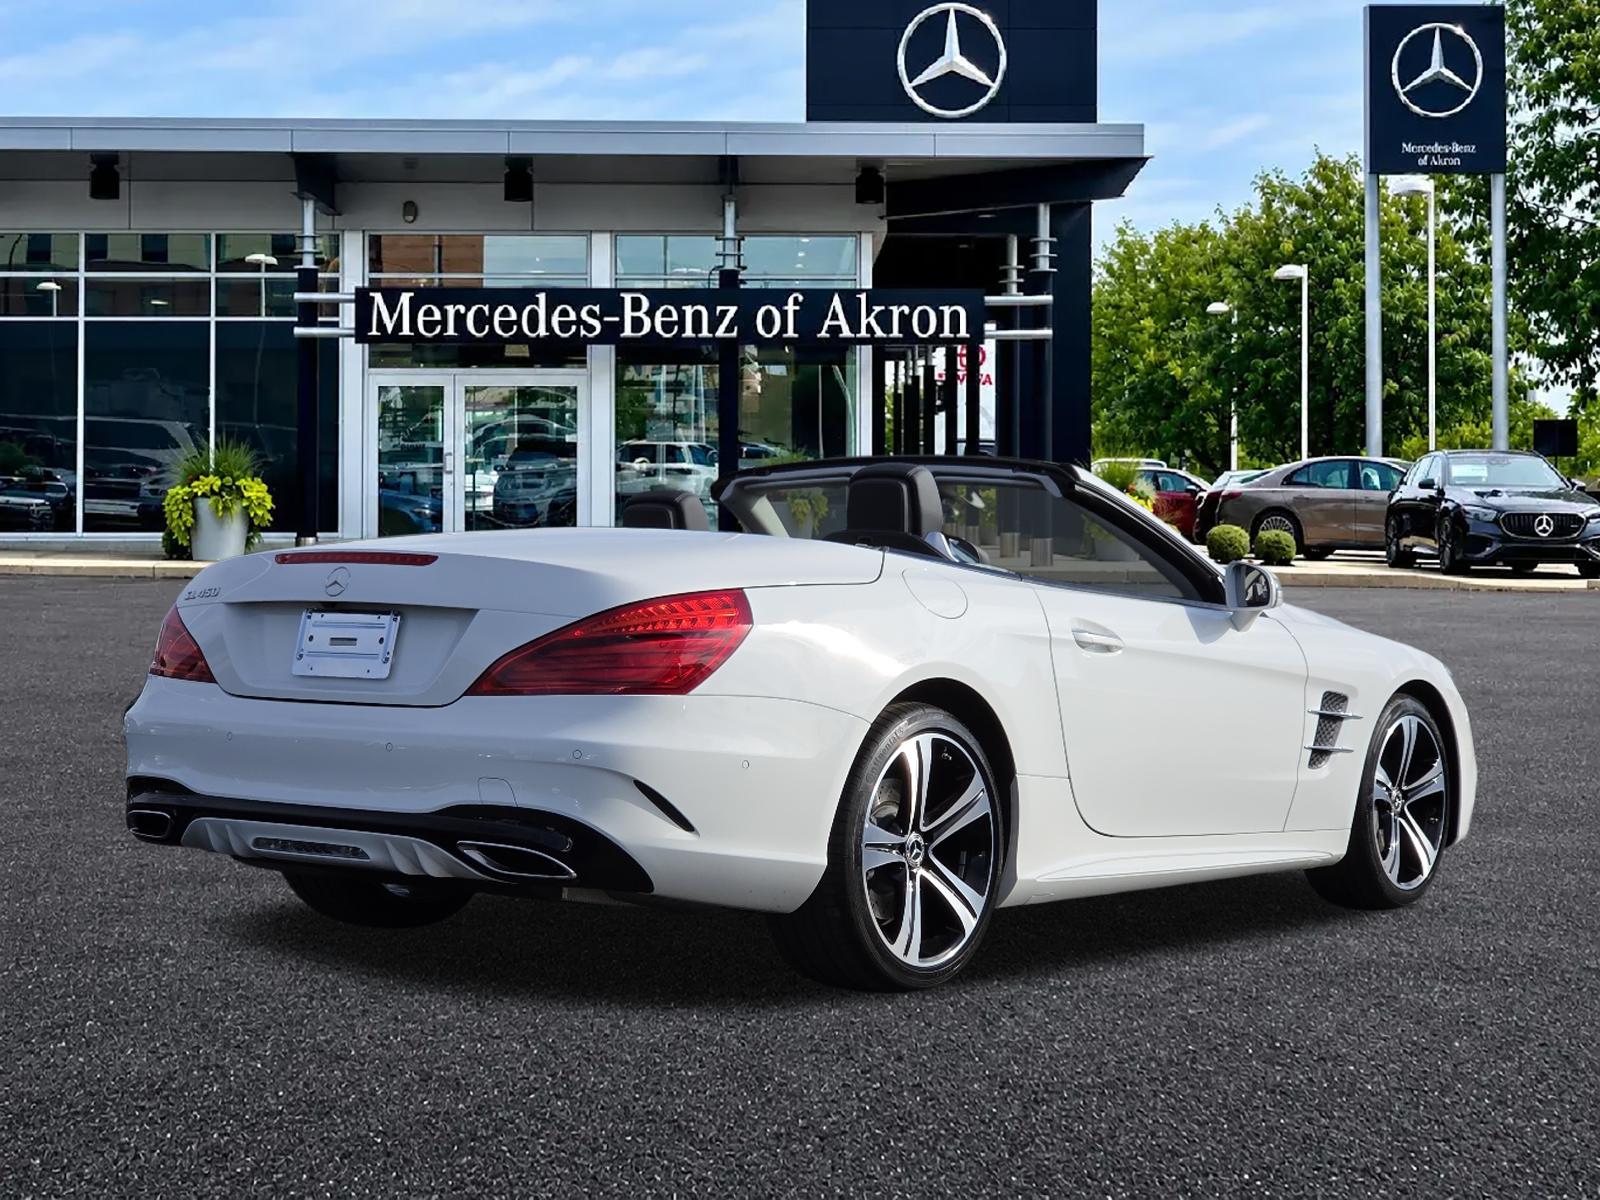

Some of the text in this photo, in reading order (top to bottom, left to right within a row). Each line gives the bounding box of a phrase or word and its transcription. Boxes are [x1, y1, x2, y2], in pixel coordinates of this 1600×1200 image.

[1401, 142, 1477, 153] Mercedes-Benz
[1418, 155, 1461, 165] of Akron
[367, 291, 970, 339] Mercedes-Benz of Akron
